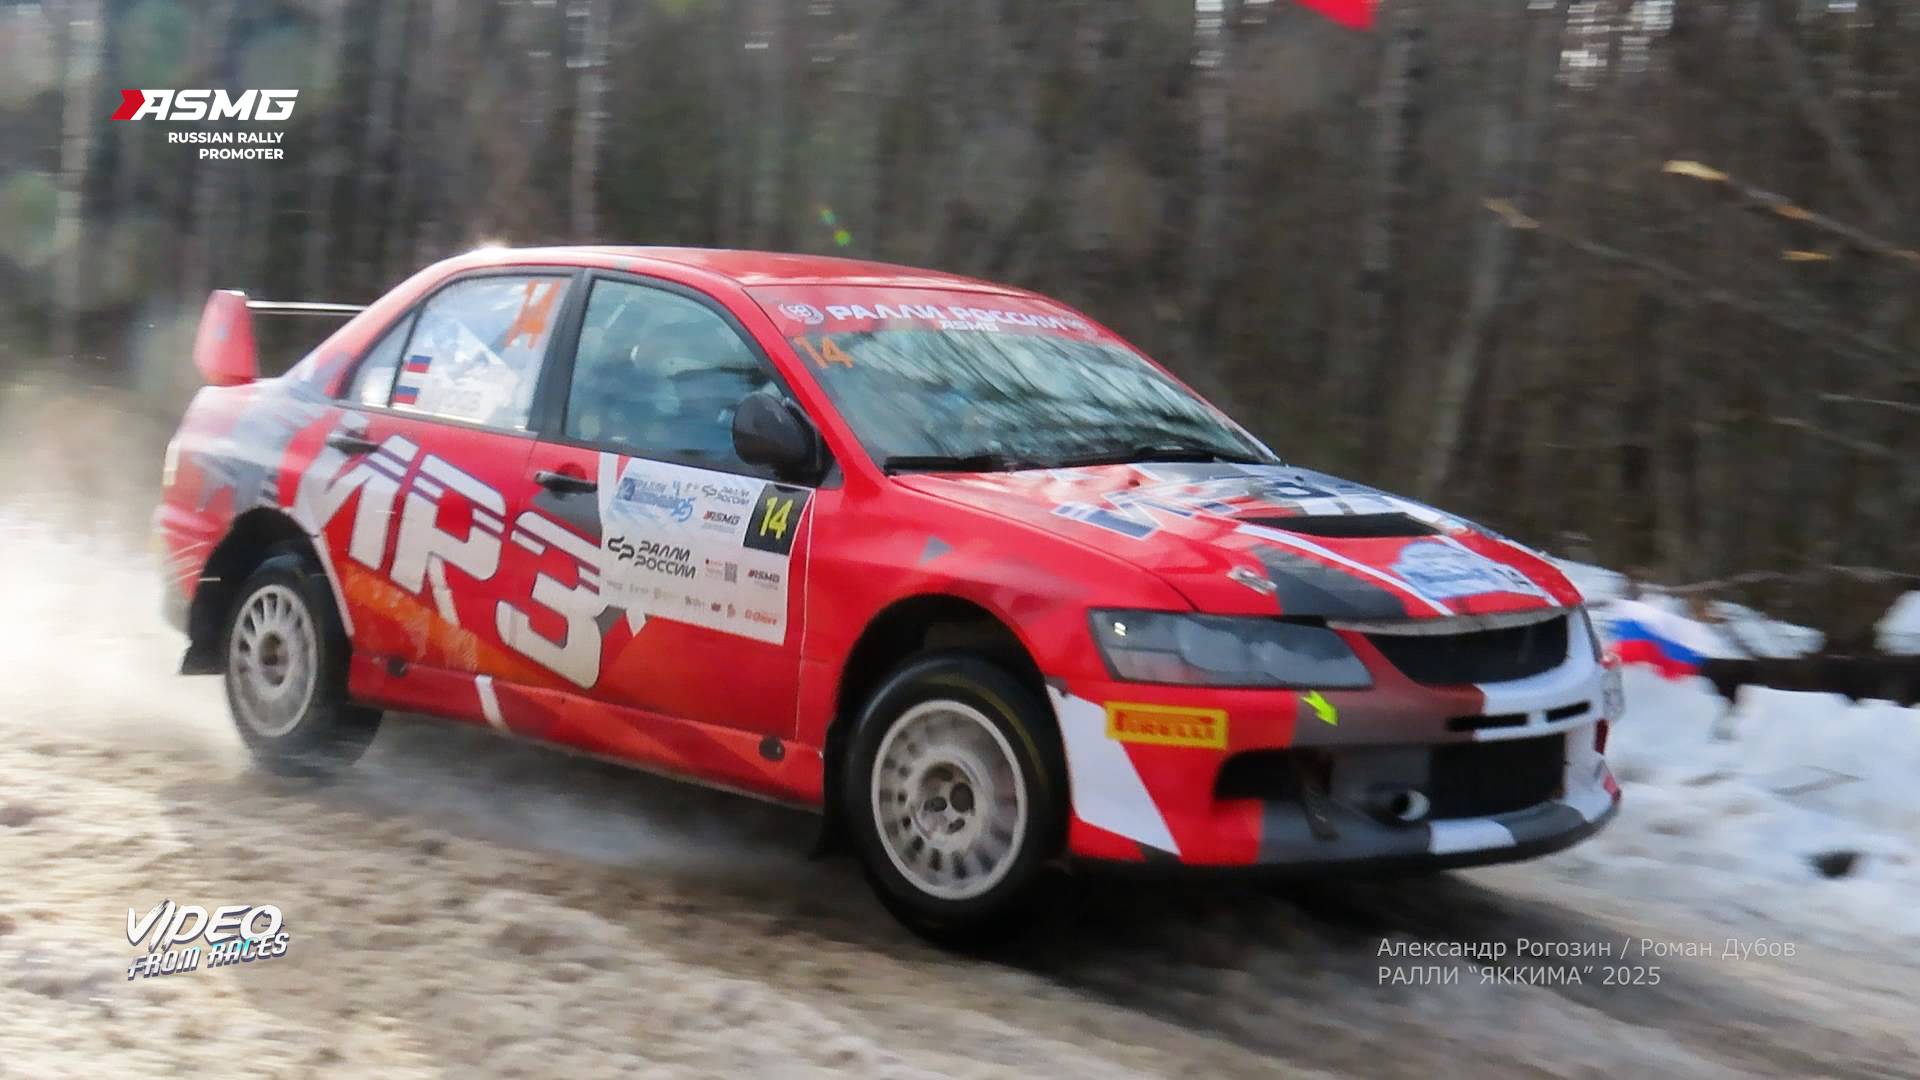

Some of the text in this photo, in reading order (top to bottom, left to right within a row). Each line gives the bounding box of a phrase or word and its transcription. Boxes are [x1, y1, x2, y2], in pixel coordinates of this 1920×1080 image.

[825, 303, 947, 322] РАЛЛИ
[948, 305, 1070, 331] РОССИИ
[793, 336, 853, 369] 14
[759, 496, 794, 540] 14
[638, 540, 692, 563] РАЛЛИ
[634, 555, 697, 580] РОССИИ
